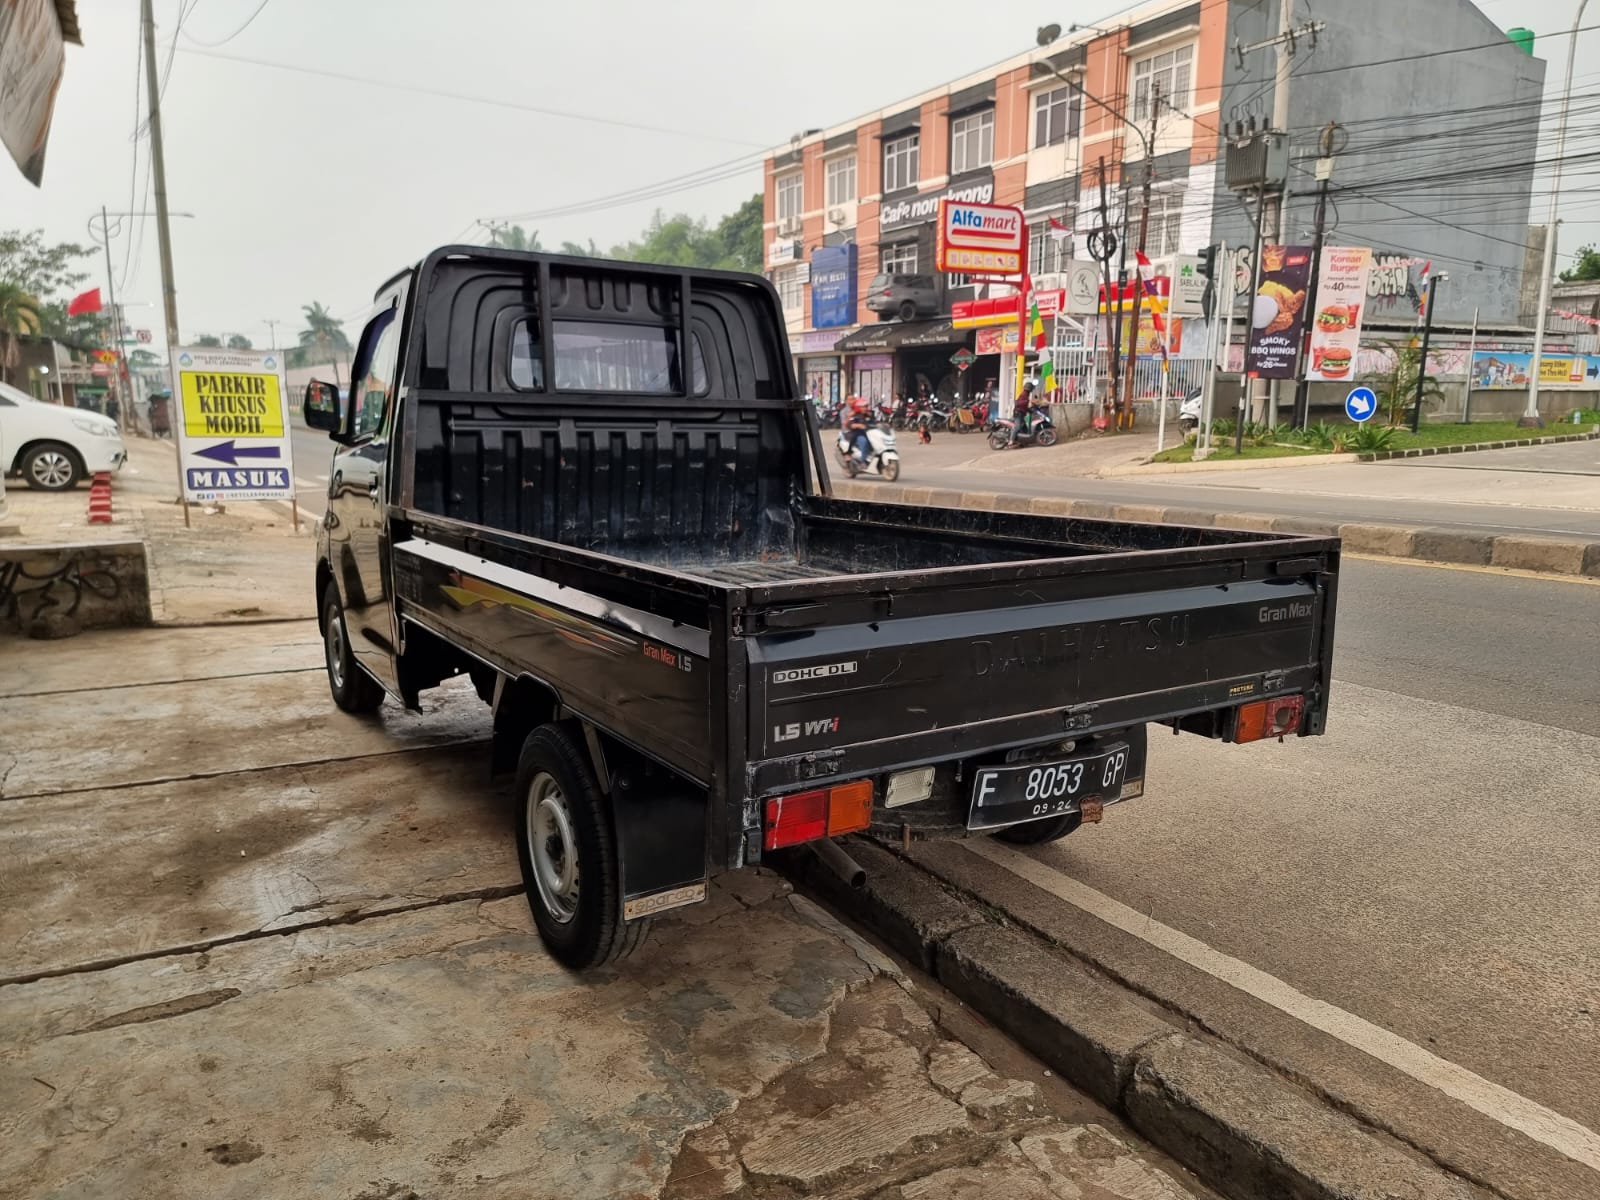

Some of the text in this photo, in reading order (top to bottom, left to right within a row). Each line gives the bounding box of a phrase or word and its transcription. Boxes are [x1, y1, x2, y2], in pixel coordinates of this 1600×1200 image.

[911, 184, 993, 218] nonkrong
[952, 210, 1017, 230] Alfamart
[1251, 346, 1296, 356] BBQ WINGS
[1260, 337, 1290, 346] SMOKY
[195, 375, 266, 394] PARKIR
[199, 395, 266, 414] KHUSUS
[205, 415, 264, 433] MOBIL
[193, 471, 285, 487] MASUK
[1259, 602, 1313, 622] Gran Max
[970, 614, 1188, 677] DAIHATSU
[643, 641, 692, 672] Gran Max 1.5
[774, 668, 823, 682] DOHC
[977, 752, 1125, 807] F 8053 GP
[635, 889, 695, 912] sparco
